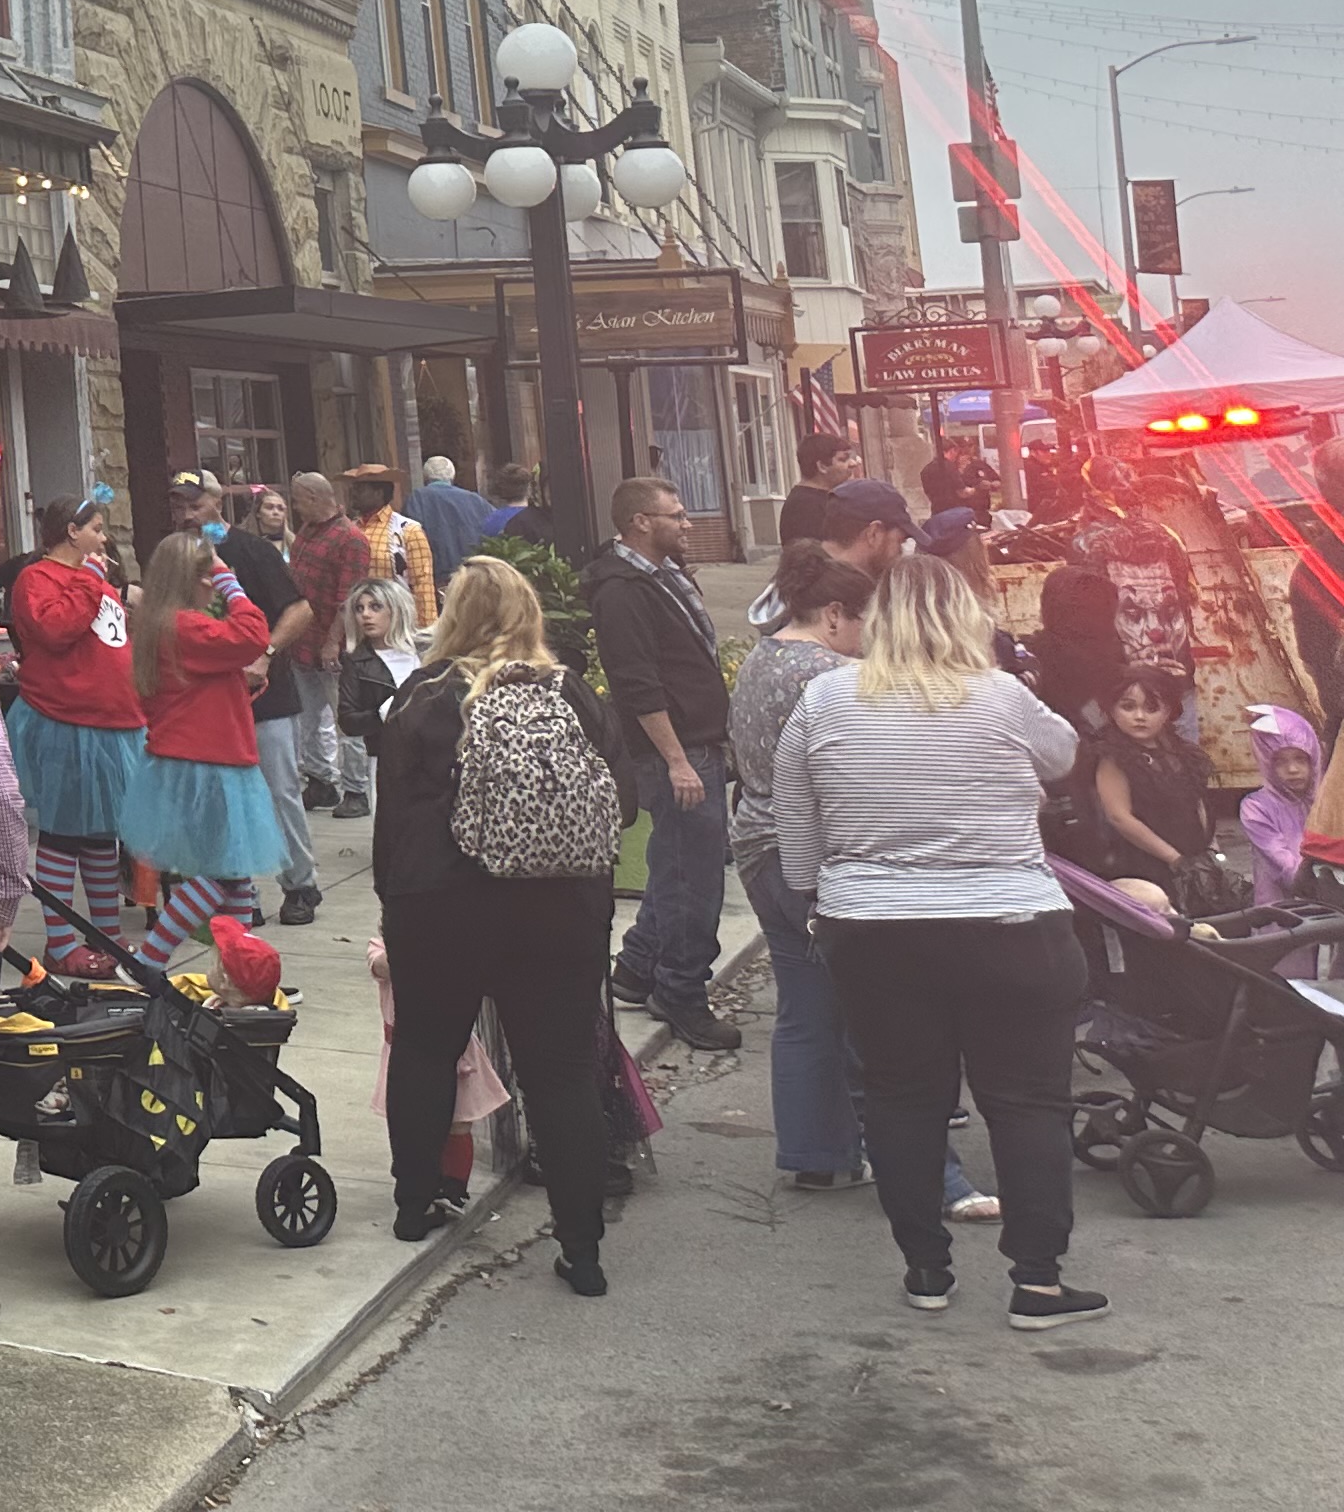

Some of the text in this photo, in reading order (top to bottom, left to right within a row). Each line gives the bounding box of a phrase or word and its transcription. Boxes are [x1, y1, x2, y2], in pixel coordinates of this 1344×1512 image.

[586, 312, 636, 330] Asian
[643, 307, 715, 328] Kitchen
[887, 338, 970, 362] BERRYMAN
[883, 366, 981, 381] LAW OFFICES
[108, 622, 123, 643] 2
